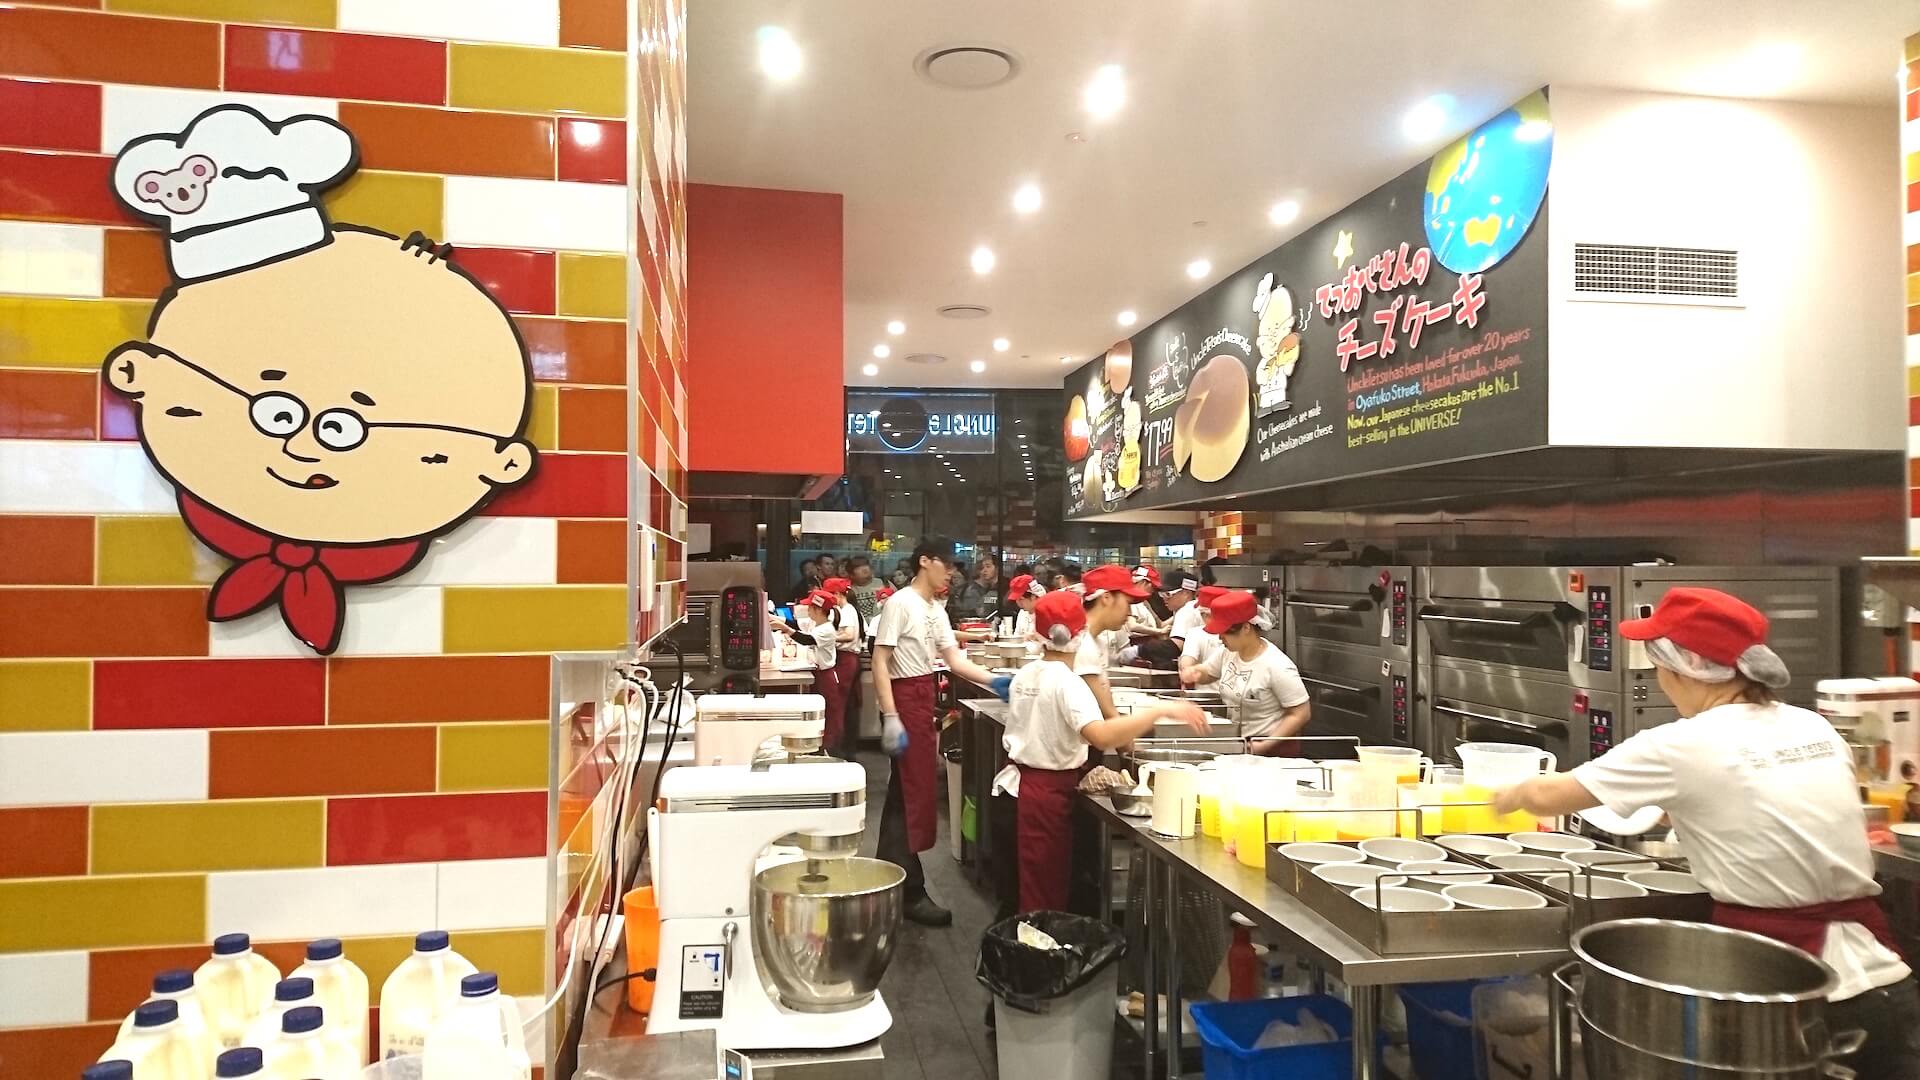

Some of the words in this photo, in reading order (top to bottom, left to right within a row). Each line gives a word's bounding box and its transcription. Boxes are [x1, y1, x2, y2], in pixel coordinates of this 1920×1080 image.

[1337, 273, 1486, 371] チーズケーキ
[1348, 370, 1368, 393] Uncle
[1366, 367, 1389, 387] Tetsu
[1389, 366, 1404, 381] has
[1405, 361, 1424, 378] been
[1425, 350, 1446, 371] loved
[1447, 347, 1461, 363] for
[1461, 343, 1484, 359] over
[1484, 332, 1500, 351] 20
[1501, 328, 1532, 350] years
[1355, 387, 1391, 412] Oyafuko
[1391, 381, 1422, 400] Street,
[1366, 415, 1380, 427] our
[1379, 407, 1410, 423] Japanese
[1411, 391, 1461, 413] cheesecakes
[1461, 389, 1477, 402] are
[1477, 381, 1494, 399] the
[1144, 416, 1173, 467] $17.99
[1257, 427, 1268, 444] Our
[1308, 400, 1321, 418] made
[1314, 424, 1333, 438] cheese
[1347, 427, 1389, 448] best-selling
[1389, 426, 1397, 438] in
[1397, 423, 1410, 436] the
[1410, 408, 1462, 434] UNIVERSE!
